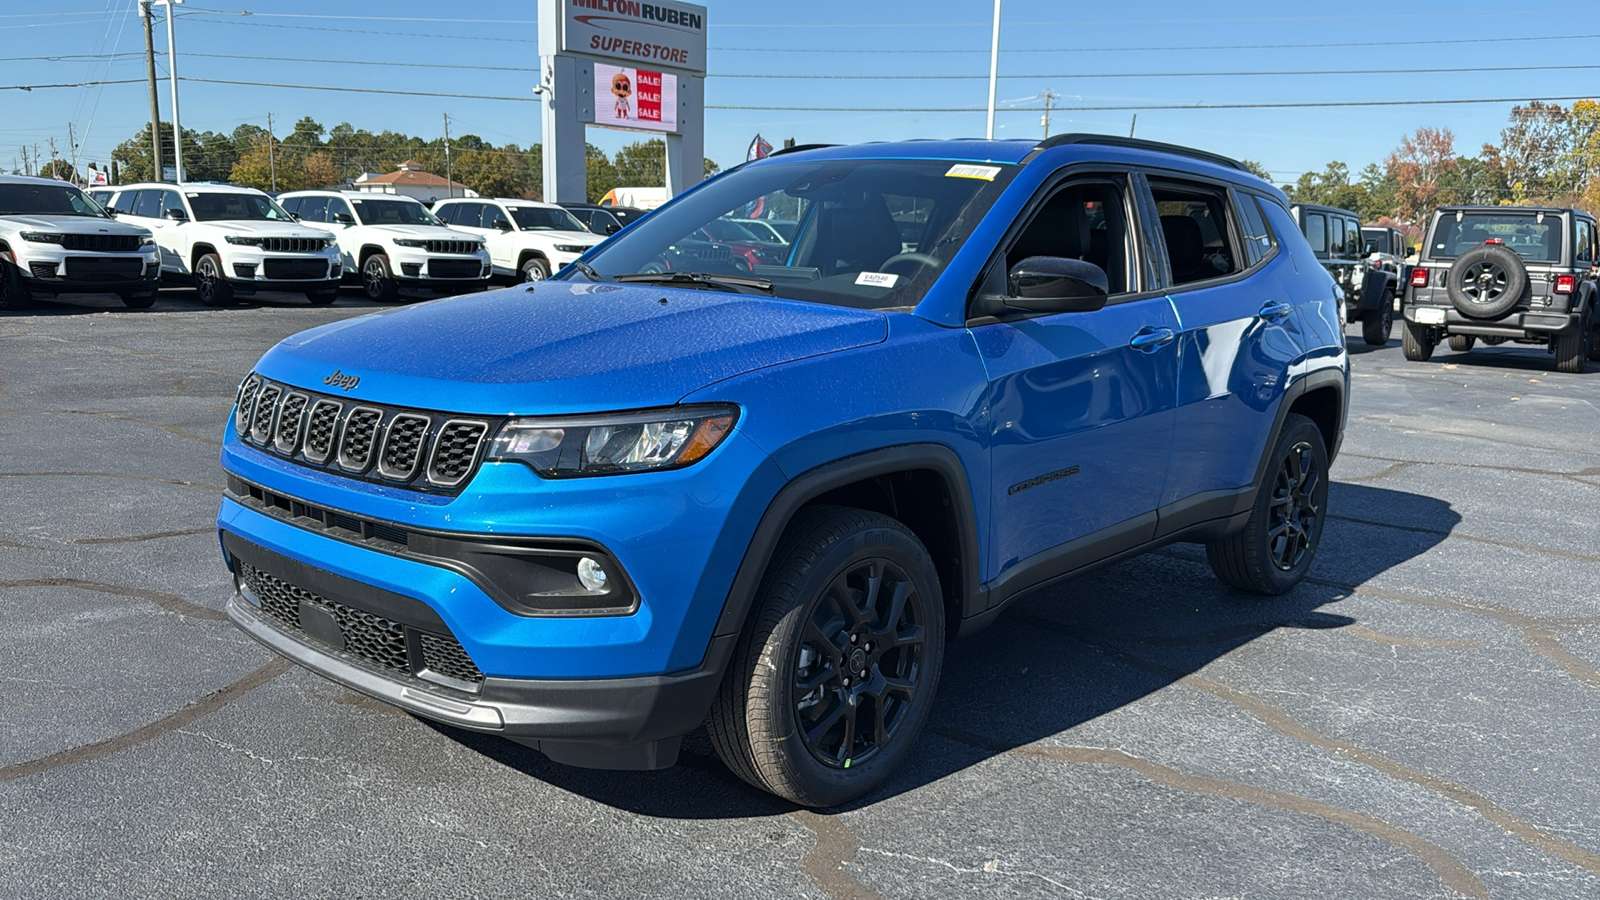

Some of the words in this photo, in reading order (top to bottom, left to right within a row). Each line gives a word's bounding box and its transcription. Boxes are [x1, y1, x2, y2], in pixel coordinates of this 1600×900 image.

[590, 35, 689, 64] SUPERSTORE
[638, 74, 661, 86] SALE!
[323, 369, 360, 391] Jeep
[1008, 465, 1080, 496] COMPASS
